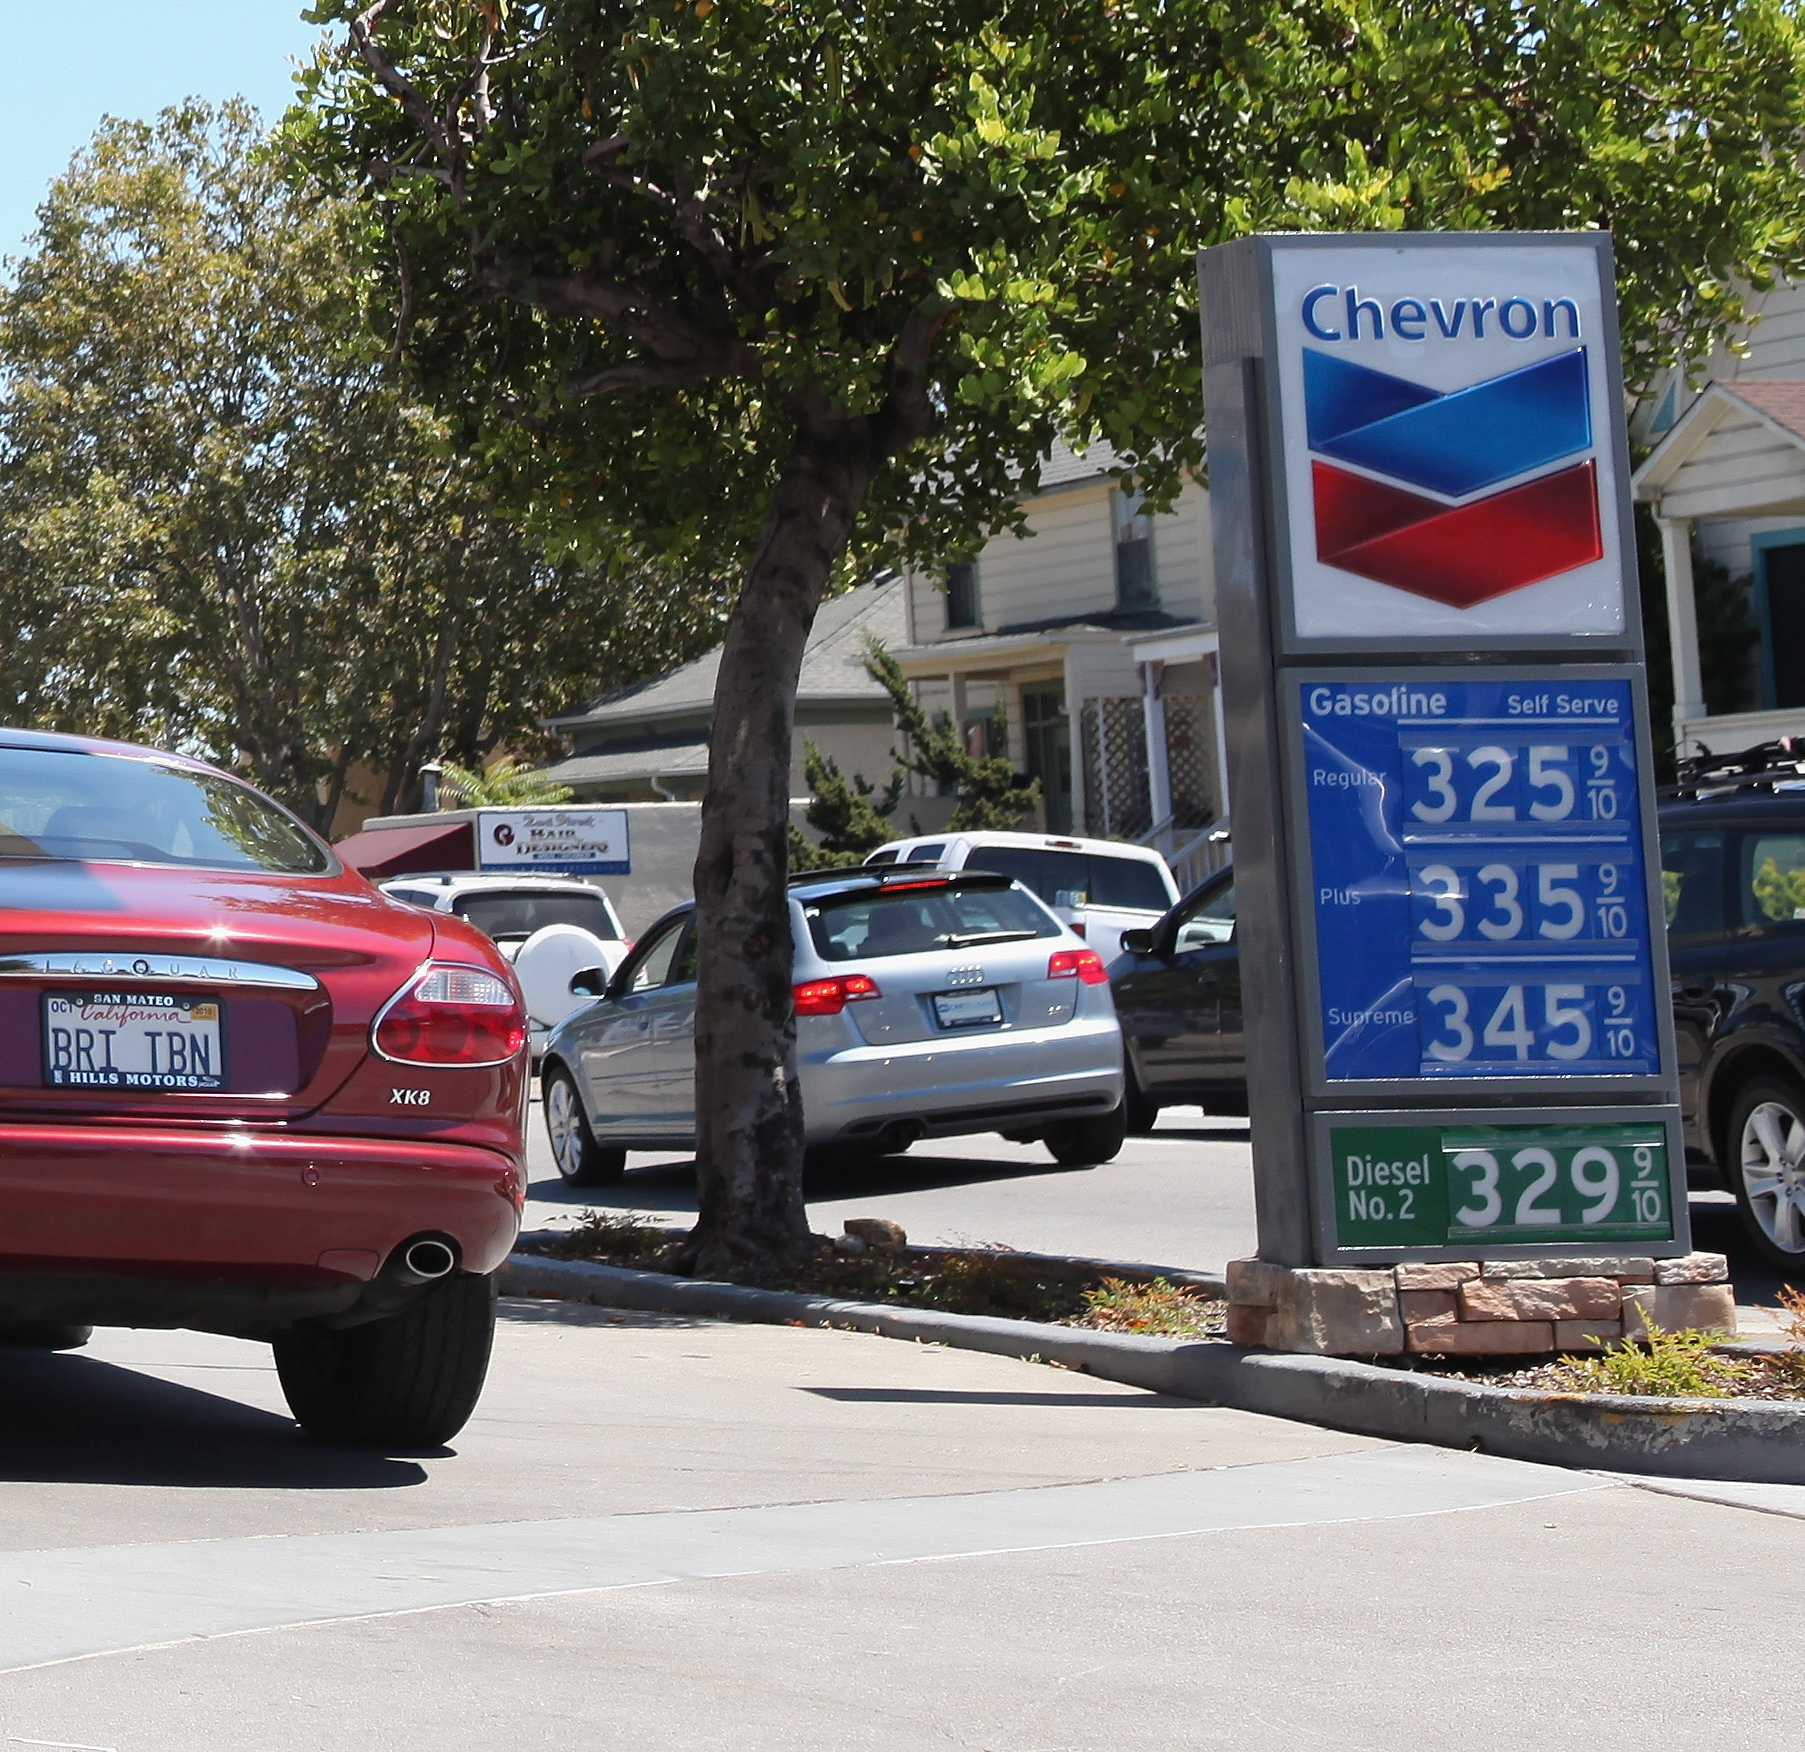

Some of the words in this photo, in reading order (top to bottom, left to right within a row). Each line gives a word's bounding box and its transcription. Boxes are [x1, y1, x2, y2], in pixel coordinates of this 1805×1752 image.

[1300, 282, 1582, 341] Chevron
[1309, 686, 1448, 716] Gasoline
[1507, 694, 1550, 715] Self
[1556, 695, 1619, 715] Serve
[1590, 744, 1610, 778] 9
[1313, 768, 1386, 791] Regular
[1410, 745, 1576, 824] 325
[1588, 787, 1618, 821] 10
[516, 842, 609, 855] DESIGNERS
[530, 829, 584, 841] HAIR
[1598, 862, 1619, 895] 9
[1320, 887, 1361, 906] Plus
[1418, 863, 1585, 942] 335
[1597, 905, 1628, 938] 10
[42, 958, 240, 980] JAGUAR
[93, 993, 121, 1004] SAN
[126, 994, 174, 1006] MATEO
[1607, 985, 1627, 1016] 9
[80, 1004, 191, 1028] California
[1328, 1007, 1414, 1026] Supreme
[1426, 983, 1592, 1062] 345
[52, 1027, 118, 1072] BRI
[144, 1031, 211, 1075] TBN
[1607, 1028, 1636, 1058] 10
[69, 1071, 119, 1084] HILLS
[126, 1073, 198, 1087] MOTORS
[389, 1088, 431, 1106] XK8
[1346, 1152, 1431, 1187] Diesel
[1633, 1146, 1653, 1180] 9
[1451, 1146, 1621, 1227] 329
[1631, 1187, 1662, 1222] 10
